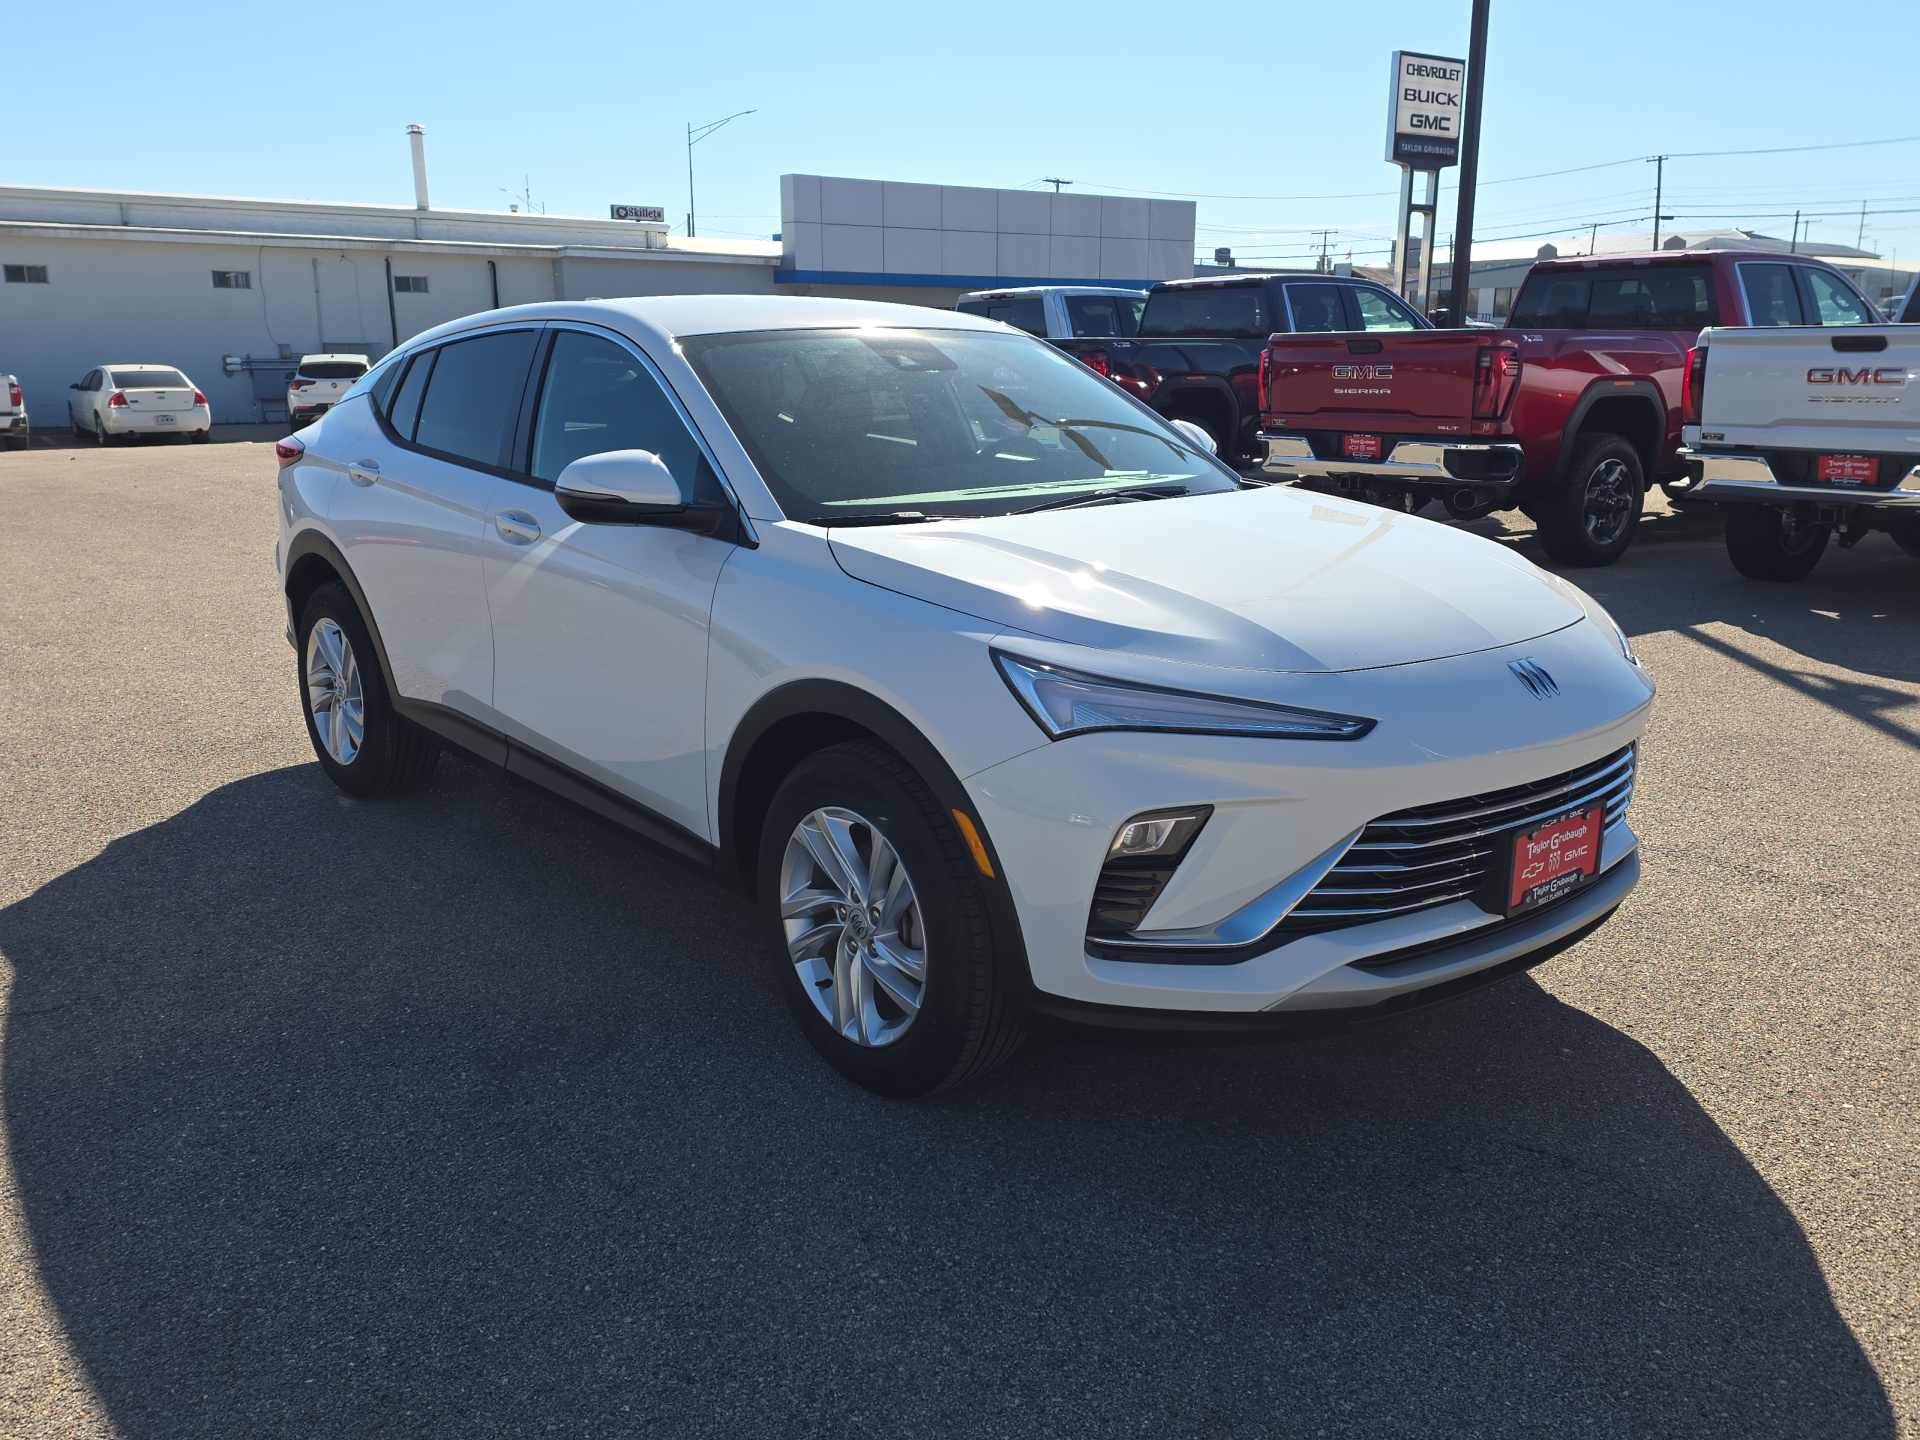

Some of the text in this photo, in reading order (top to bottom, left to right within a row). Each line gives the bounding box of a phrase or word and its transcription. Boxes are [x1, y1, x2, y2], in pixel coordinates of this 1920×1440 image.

[1406, 63, 1461, 81] CHEVROLET
[1403, 88, 1458, 107] BUICK
[1409, 113, 1451, 131] GMC
[1401, 143, 1455, 156] TAYLOR GRUBAUGH
[628, 207, 662, 218] Skillets
[1332, 365, 1393, 379] GMC
[1807, 367, 1906, 385] GMC
[1569, 808, 1584, 819] GMC
[1527, 825, 1587, 859] Taylor Grubaugh
[1564, 845, 1588, 861] GMC
[1532, 884, 1550, 900] Taylor
[1550, 872, 1577, 892] Grubaugh
